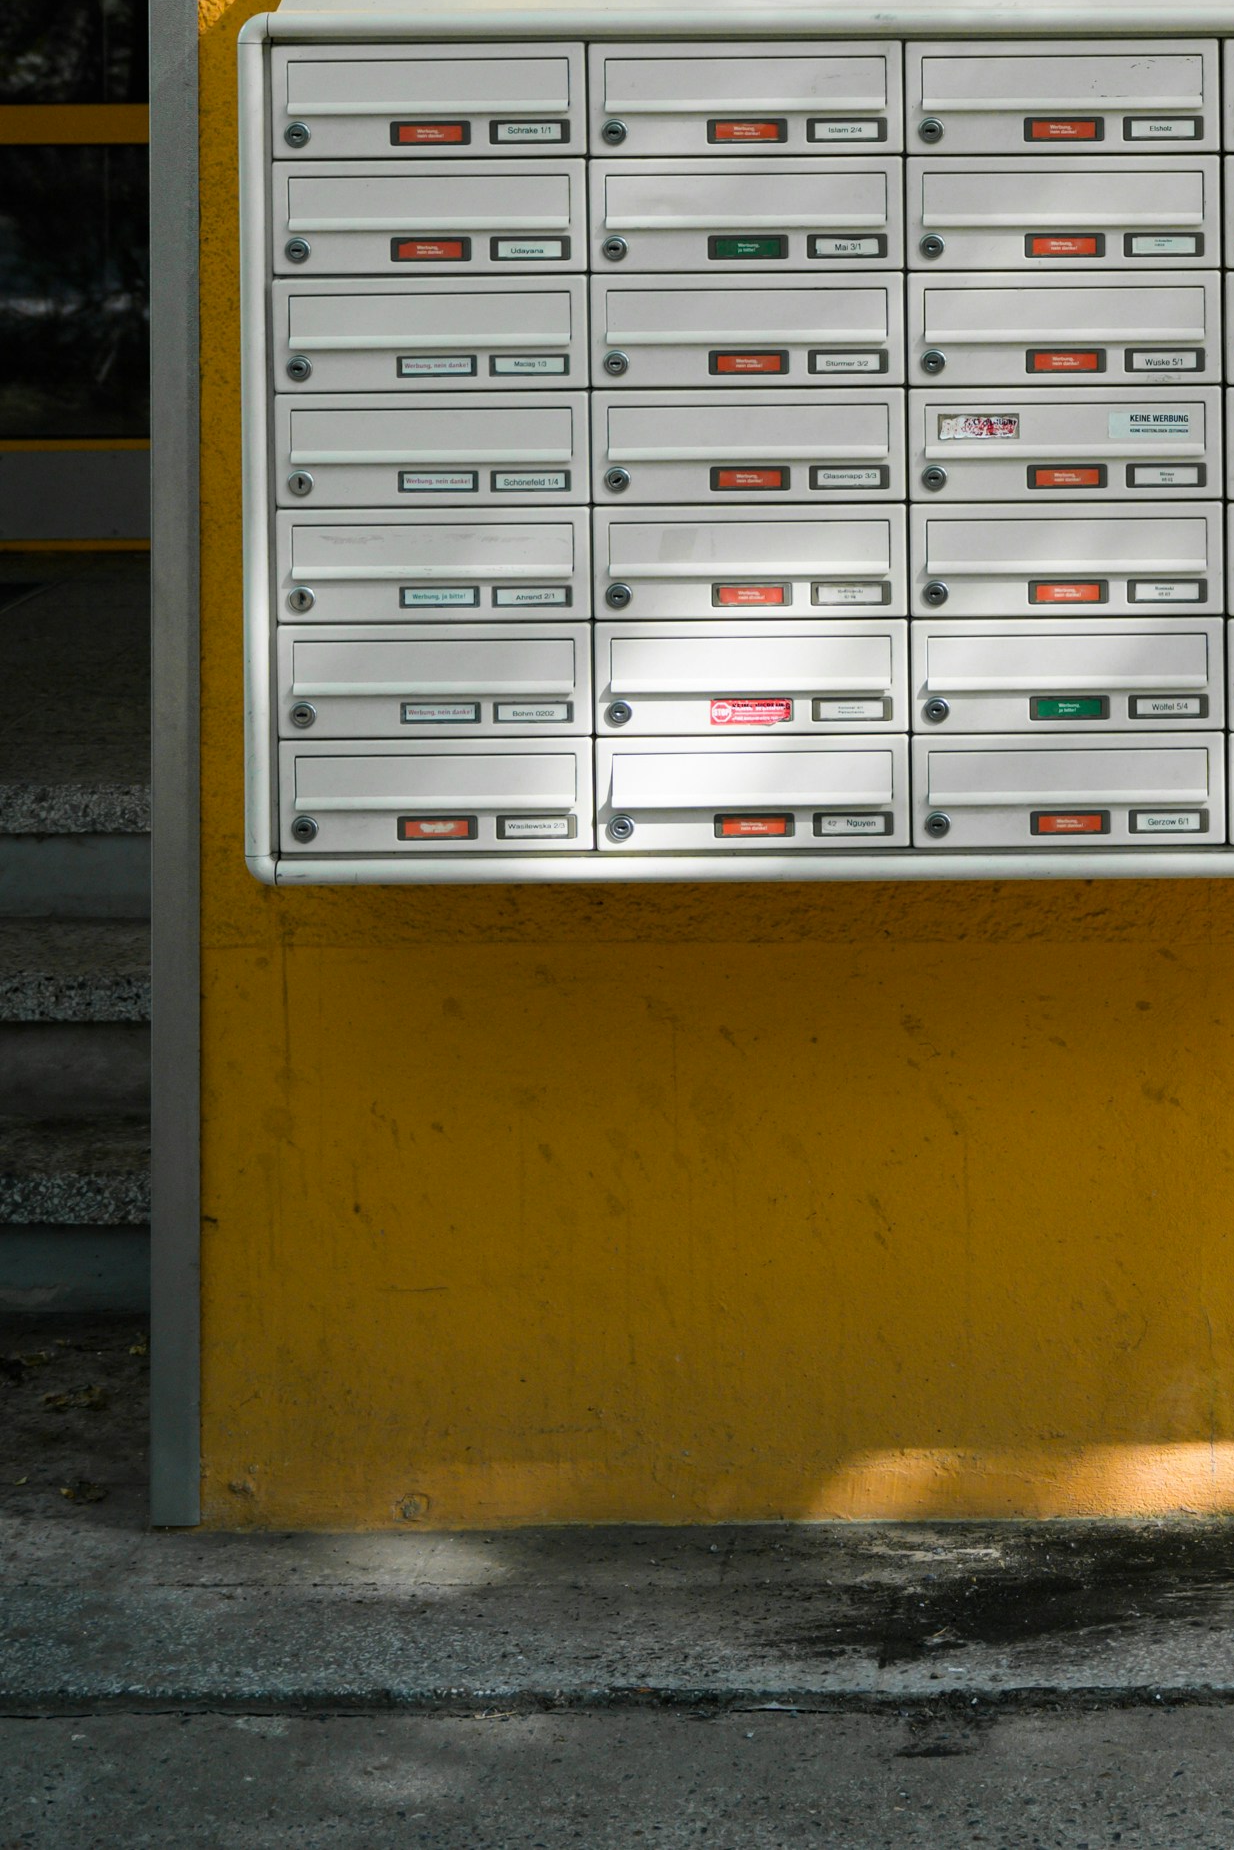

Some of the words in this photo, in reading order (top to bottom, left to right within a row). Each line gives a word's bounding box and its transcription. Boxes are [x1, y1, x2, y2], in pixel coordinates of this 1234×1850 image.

[508, 126, 538, 134] Schrake
[540, 126, 551, 134] 1/1
[510, 247, 544, 255] Udayana
[835, 243, 848, 251] Mai
[404, 362, 432, 370] Werbung,
[448, 361, 469, 369] danke!
[1145, 358, 1170, 366] Wuske
[1129, 414, 1151, 423] KEINE
[1152, 414, 1189, 423] WERBUNG
[450, 477, 470, 485] danke!
[504, 478, 545, 486] Schönefeld
[413, 593, 440, 601] Werbung,
[516, 593, 541, 601] Ahrend
[408, 709, 435, 717] Werbung,
[452, 708, 472, 716] danke!
[553, 821, 565, 829] 2/3
[846, 819, 876, 827] Nguyen
[1148, 818, 1176, 826] Gerzow
